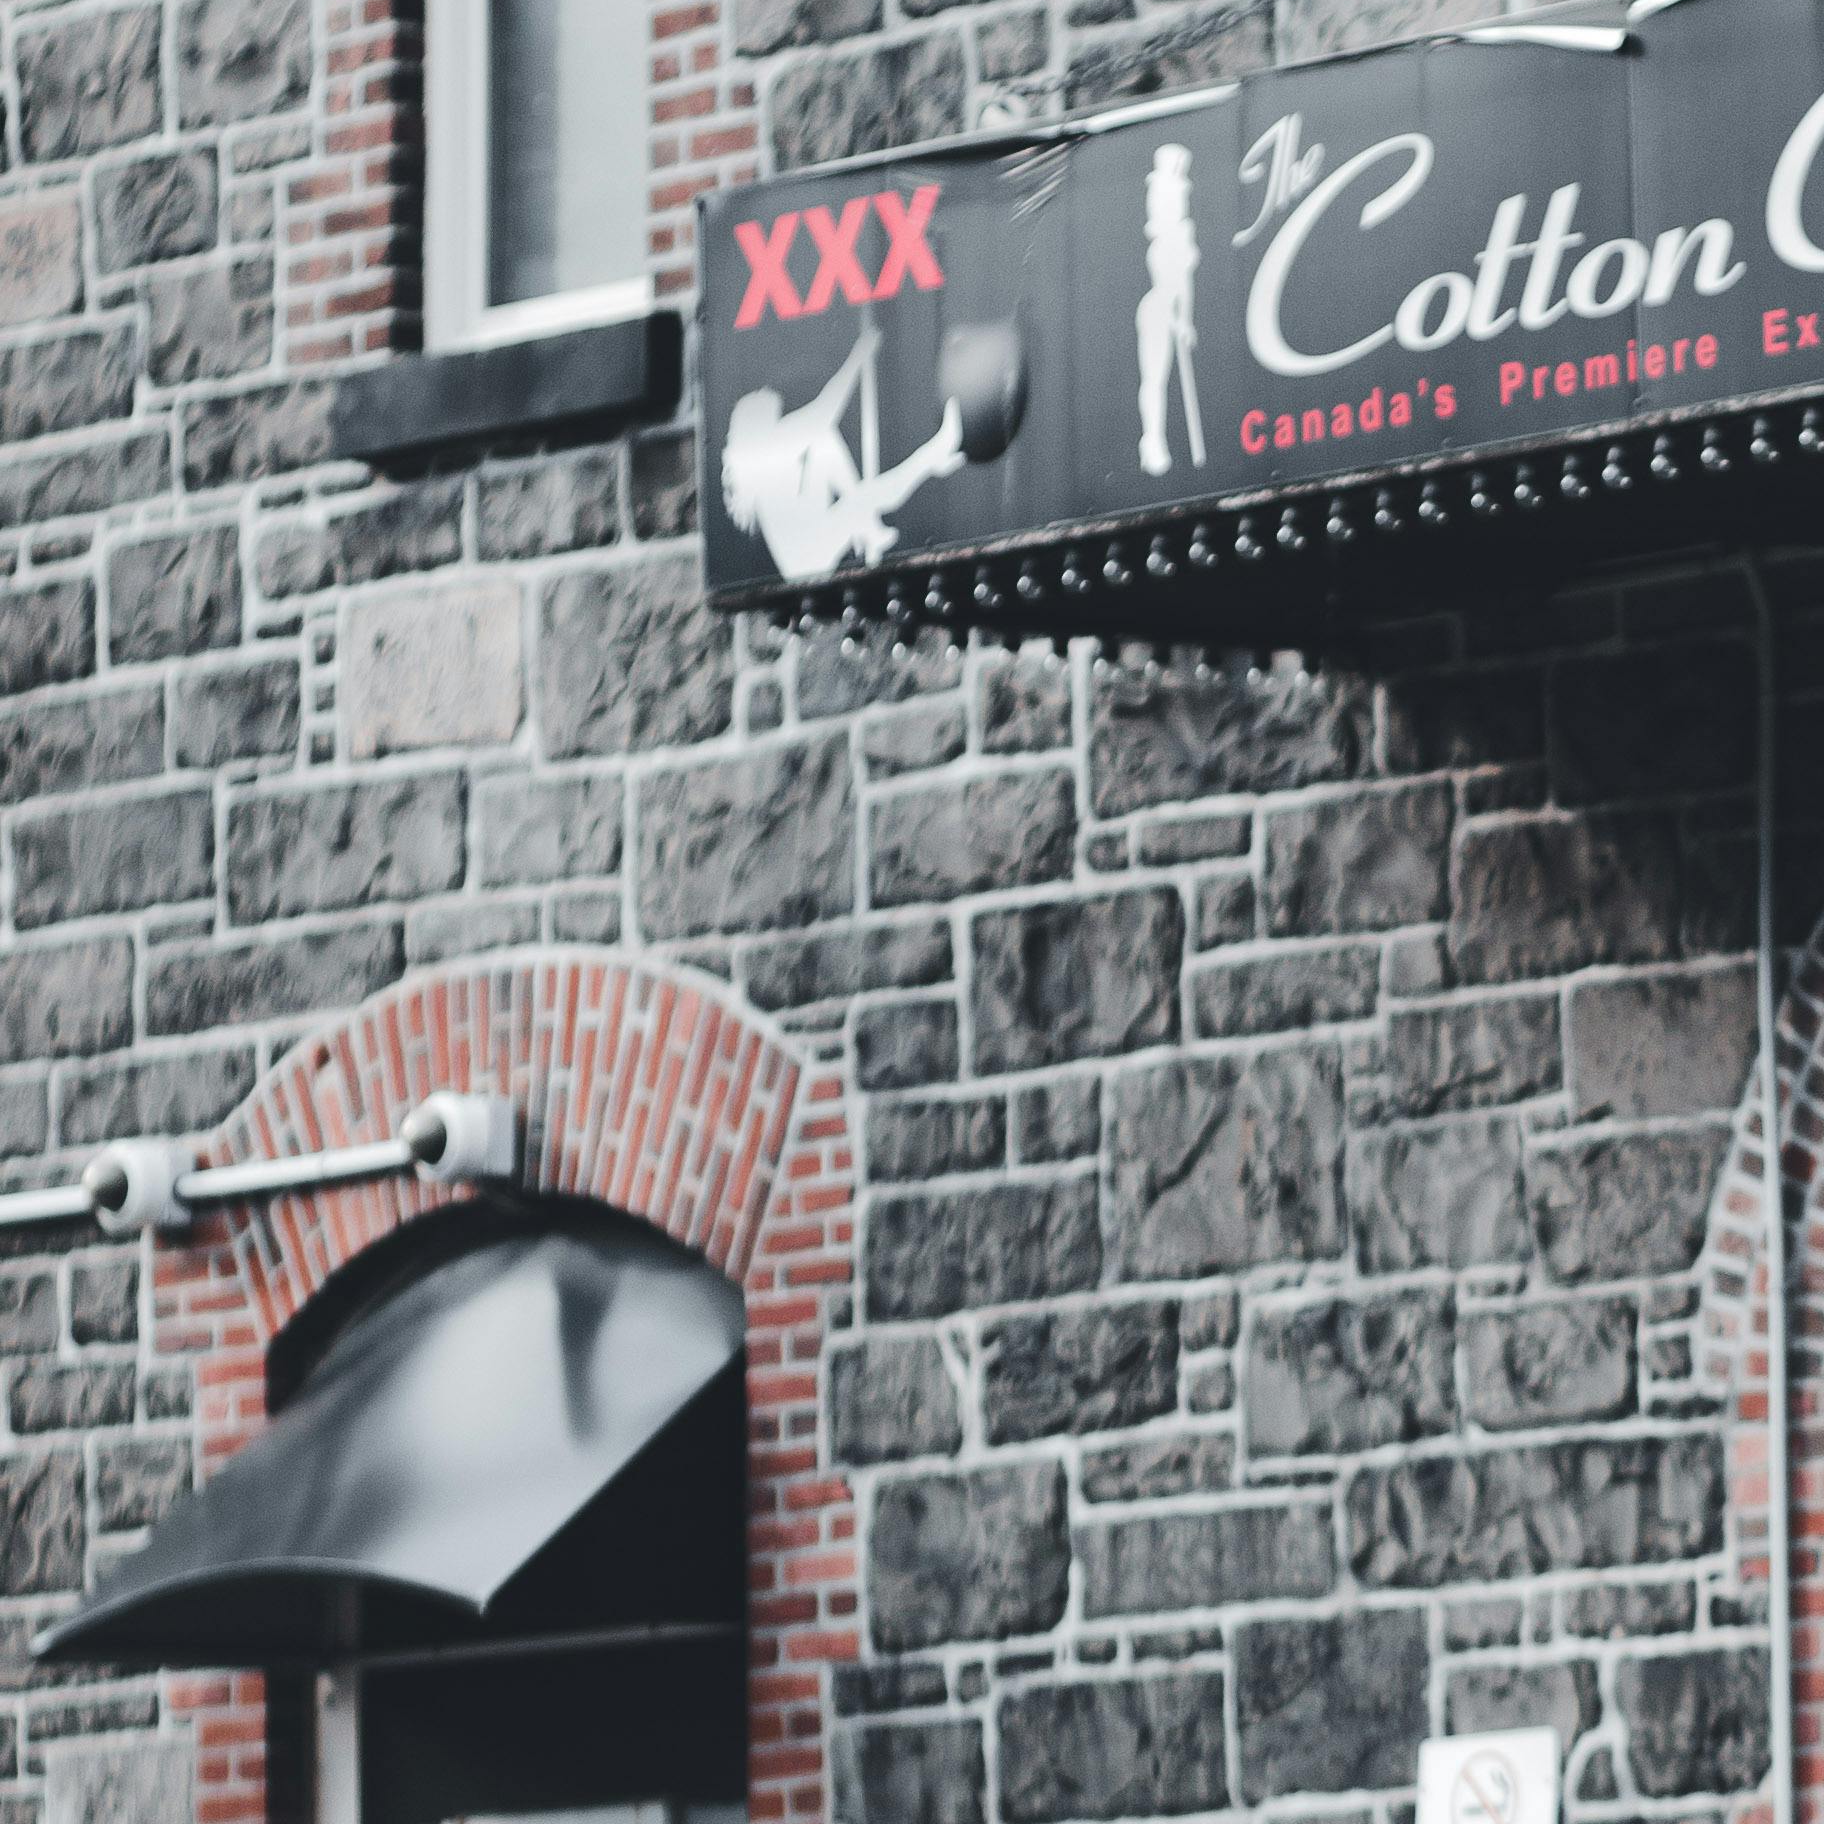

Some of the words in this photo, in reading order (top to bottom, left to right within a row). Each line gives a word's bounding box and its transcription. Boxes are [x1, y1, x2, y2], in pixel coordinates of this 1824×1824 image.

[1232, 113, 1328, 249] The
[735, 185, 945, 329] XXX
[1245, 132, 1747, 376] Cotton
[1240, 379, 1456, 454] Canada's
[1500, 335, 1718, 406] Premiere
